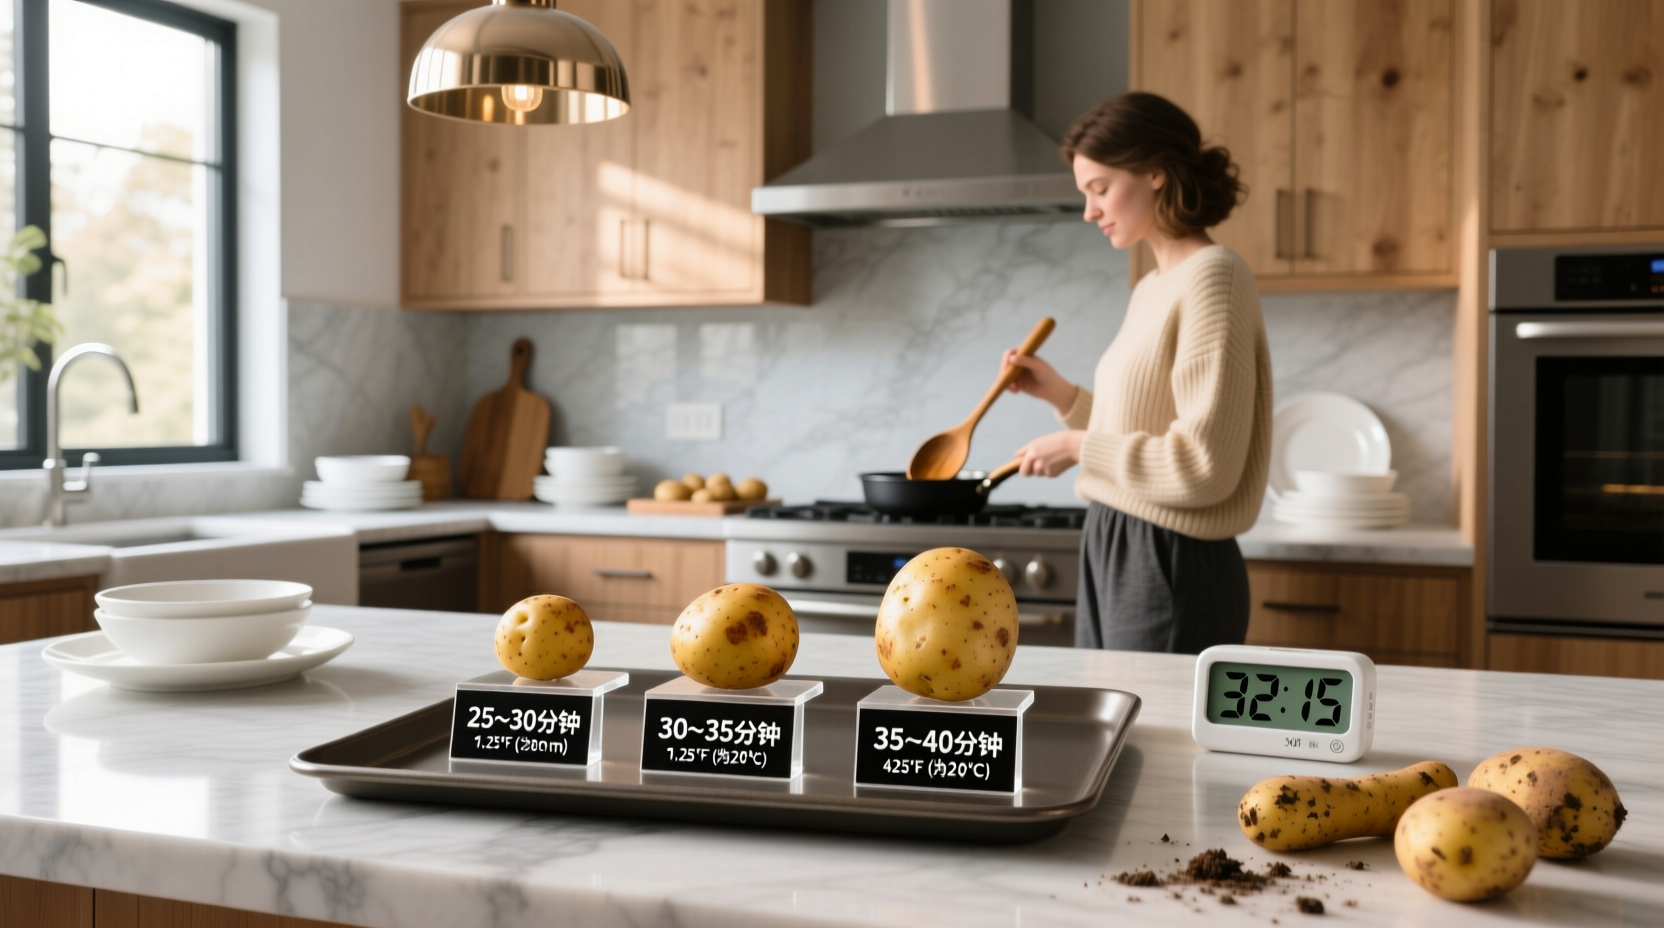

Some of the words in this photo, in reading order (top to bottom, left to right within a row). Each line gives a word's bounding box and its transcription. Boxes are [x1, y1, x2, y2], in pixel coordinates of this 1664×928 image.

[1219, 671, 1343, 727] 32:15
[466, 705, 581, 735] 25~30分钟
[658, 716, 781, 747] 30~35分钟
[873, 726, 1003, 758] 35~40分钟
